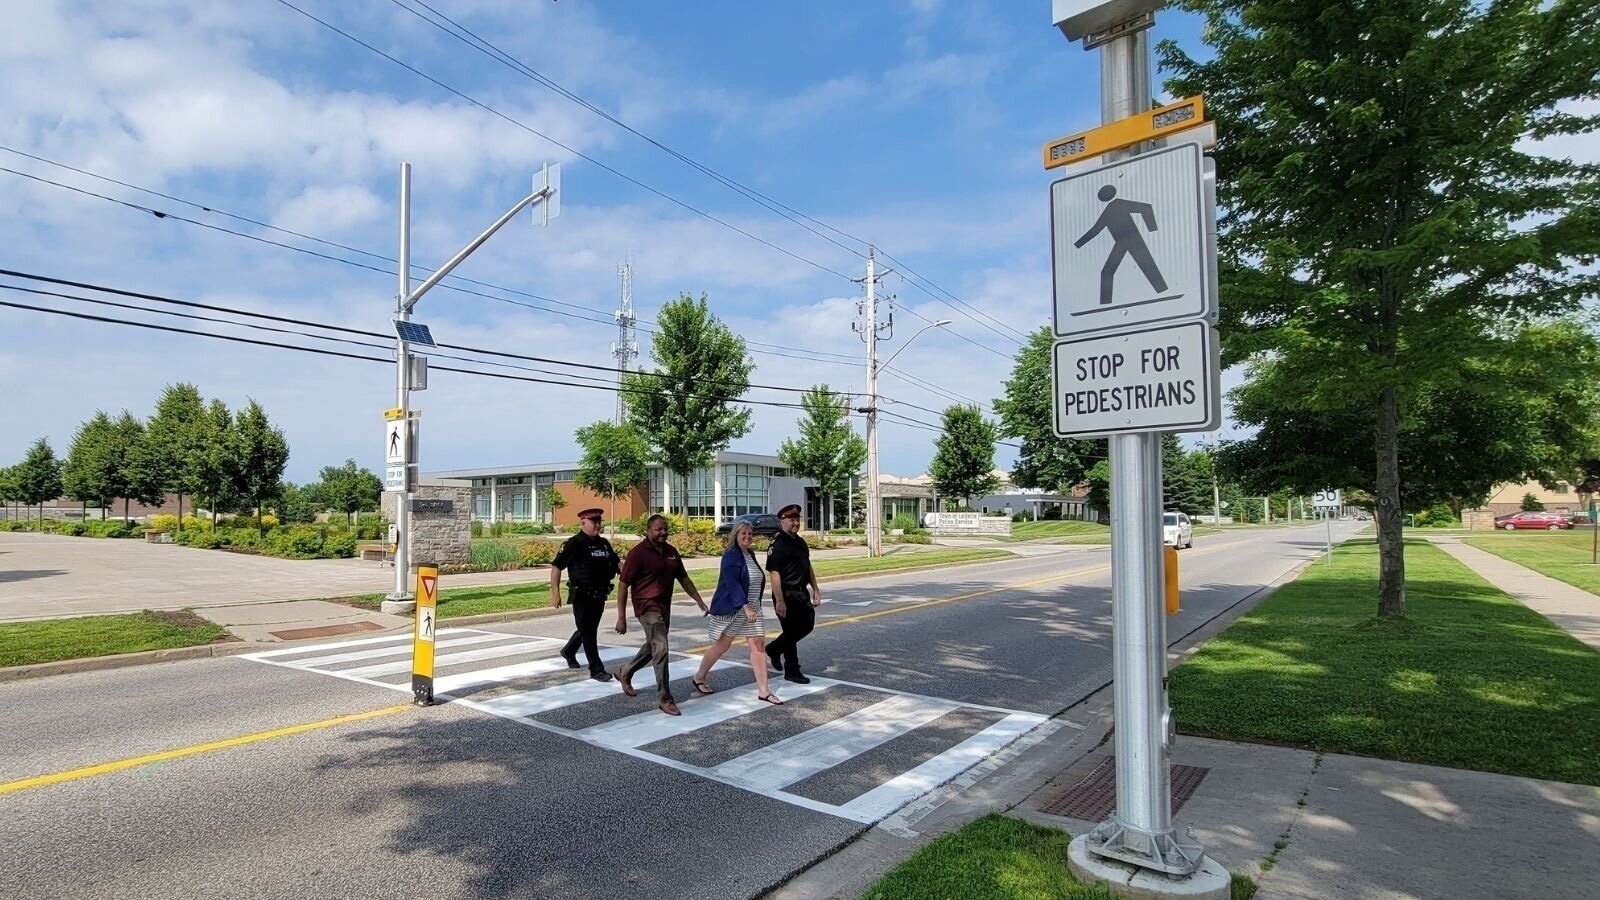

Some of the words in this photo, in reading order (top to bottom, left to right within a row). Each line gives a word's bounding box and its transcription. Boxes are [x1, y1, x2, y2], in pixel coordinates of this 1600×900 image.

[1076, 353, 1124, 381] STOP
[1141, 345, 1180, 374] FOR
[1065, 379, 1196, 416] PEDESTRIANS
[1315, 490, 1336, 502] 50
